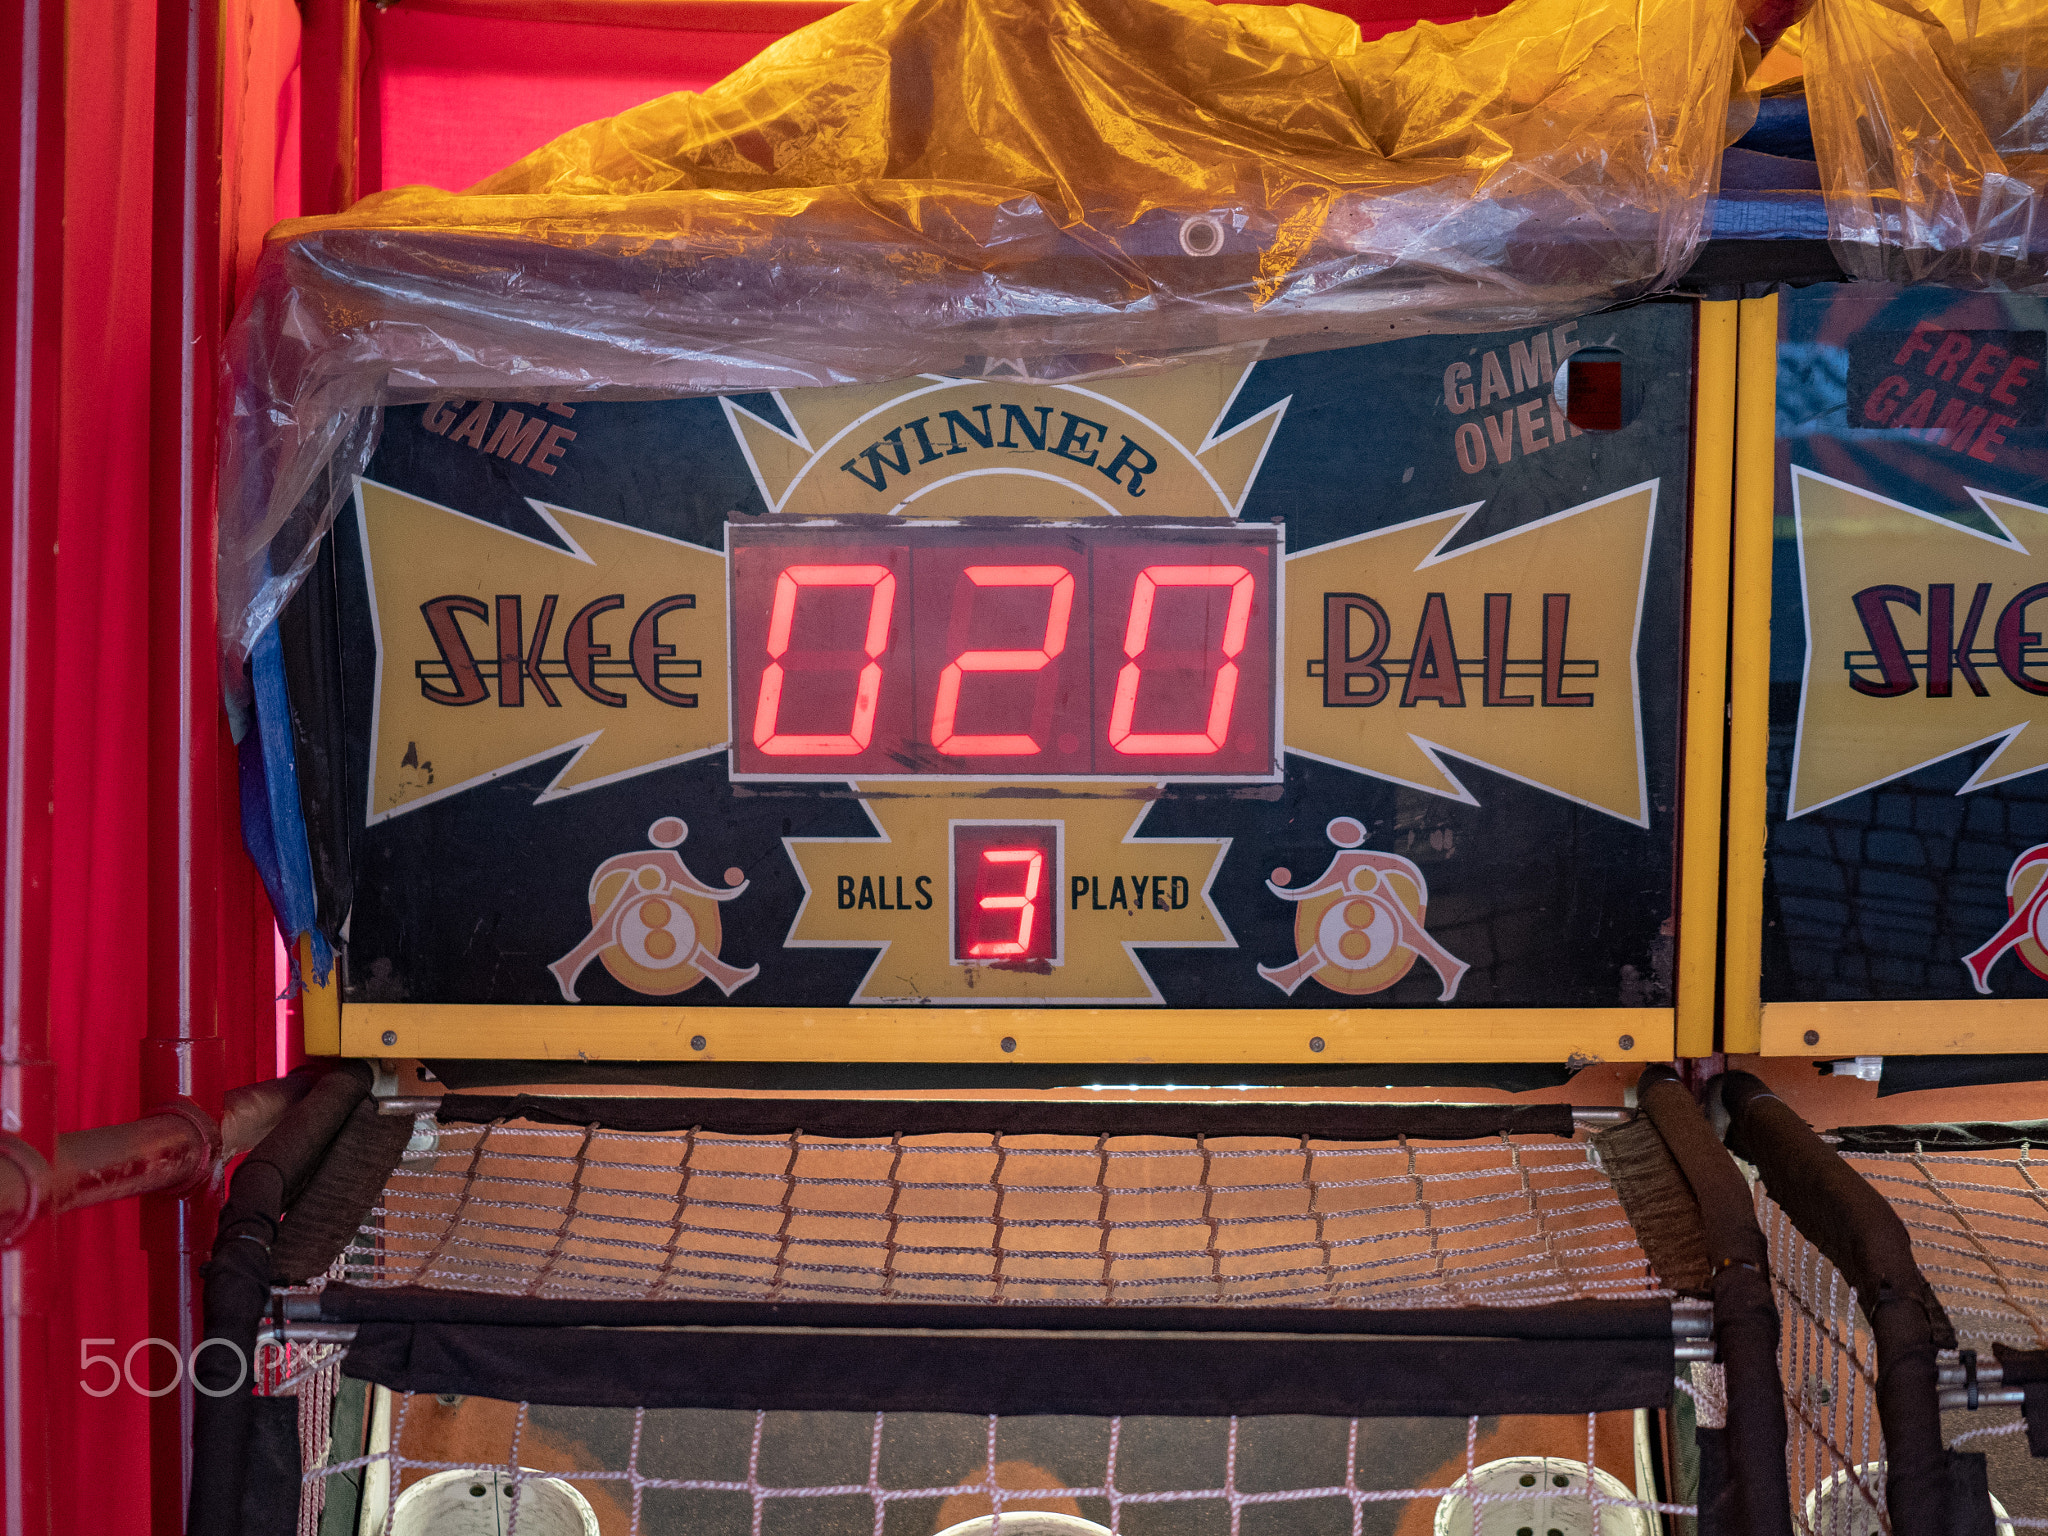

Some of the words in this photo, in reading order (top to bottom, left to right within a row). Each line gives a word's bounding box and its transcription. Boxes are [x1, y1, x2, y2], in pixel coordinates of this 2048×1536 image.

[1444, 321, 1581, 415] GAME
[1893, 321, 2040, 406] FREE
[422, 398, 578, 476] GAME
[840, 402, 1159, 497] WINNER
[1863, 374, 2017, 463] GAME
[415, 593, 702, 708] SKEE
[1307, 592, 1599, 708] BALL
[752, 563, 1256, 757] 020
[836, 875, 934, 911] BALLS
[1070, 875, 1190, 911] PLAYED
[968, 848, 1043, 955] 3
